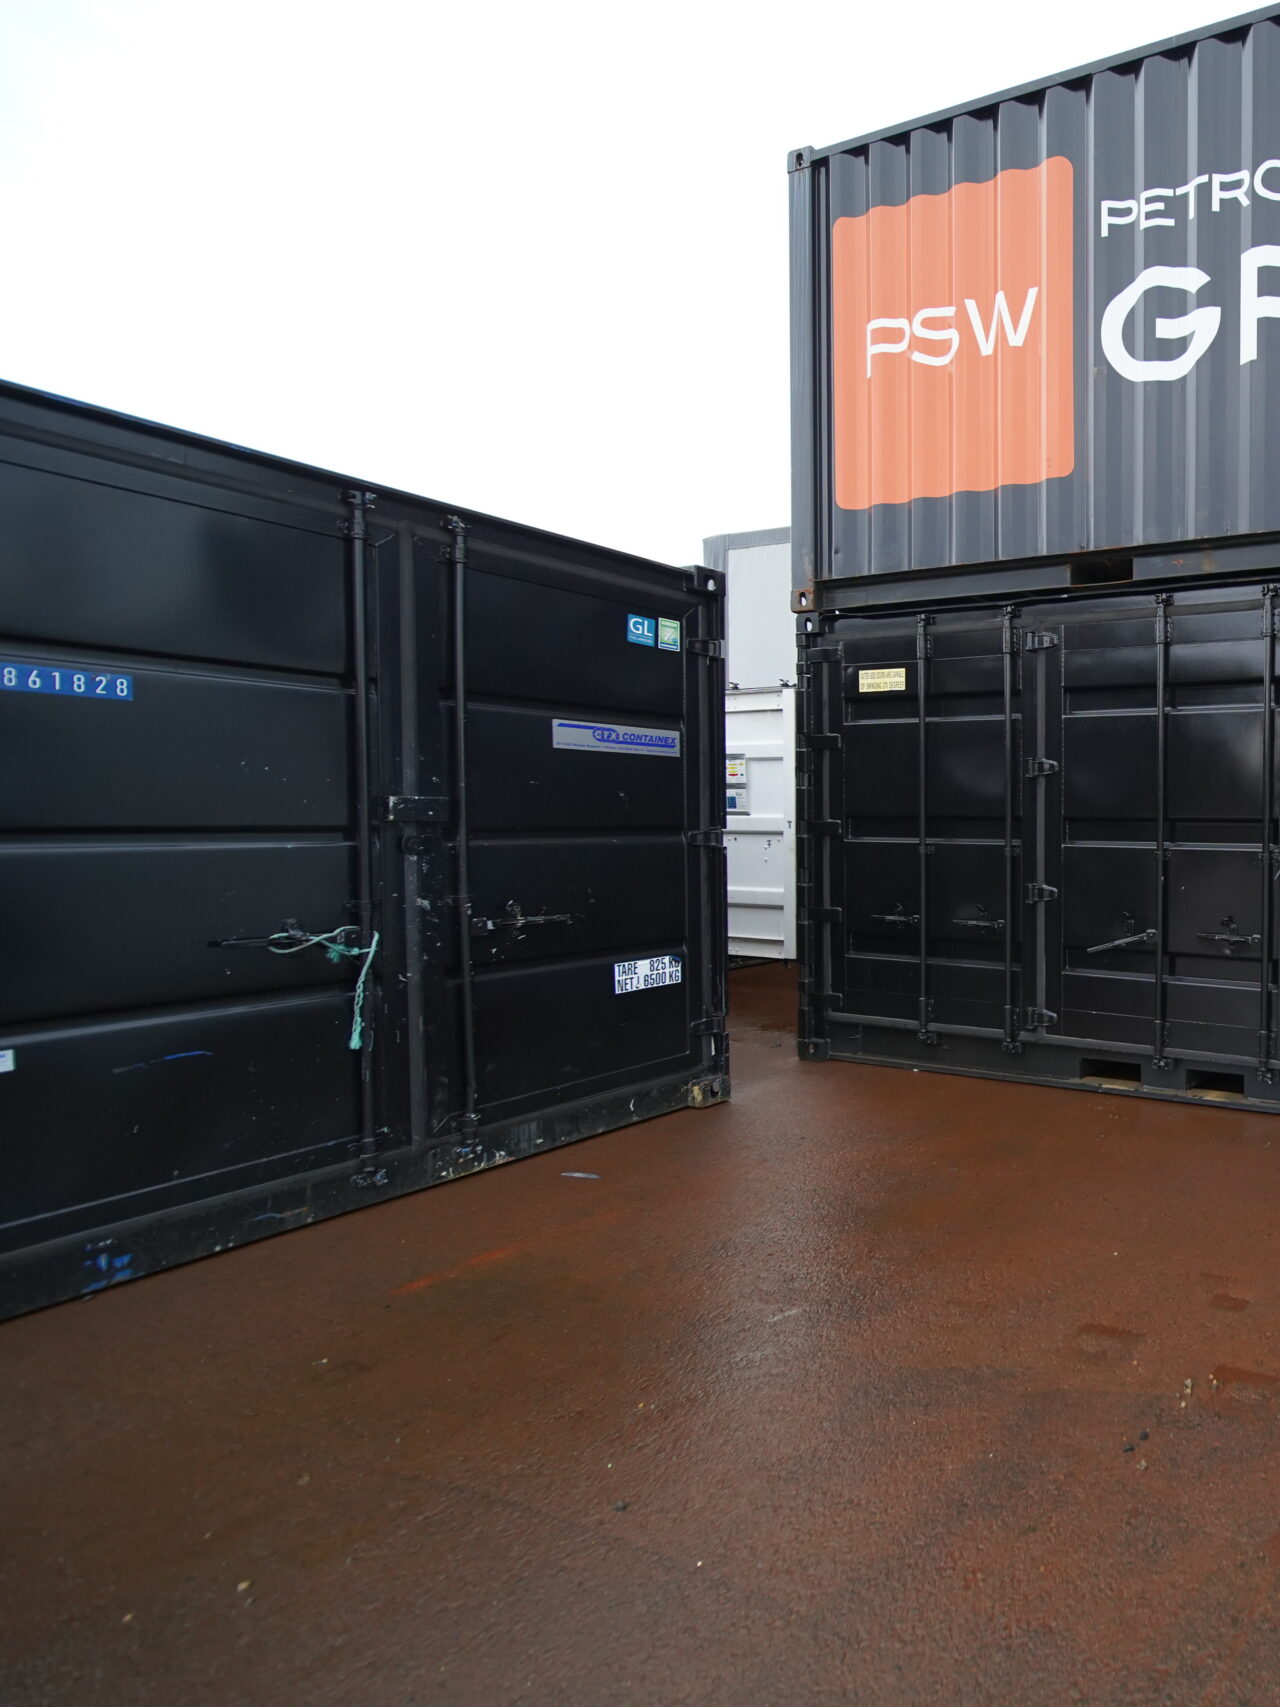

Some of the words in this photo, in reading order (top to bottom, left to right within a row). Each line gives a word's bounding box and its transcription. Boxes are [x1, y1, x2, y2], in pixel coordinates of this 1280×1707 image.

[867, 287, 1038, 377] PSW
[629, 618, 653, 637] GL
[3, 667, 128, 696] 861828
[622, 732, 677, 745] CONTAINEX
[616, 961, 638, 977] TARE
[649, 957, 667, 972] 825
[643, 971, 667, 987] 6500
[668, 969, 680, 983] KG
